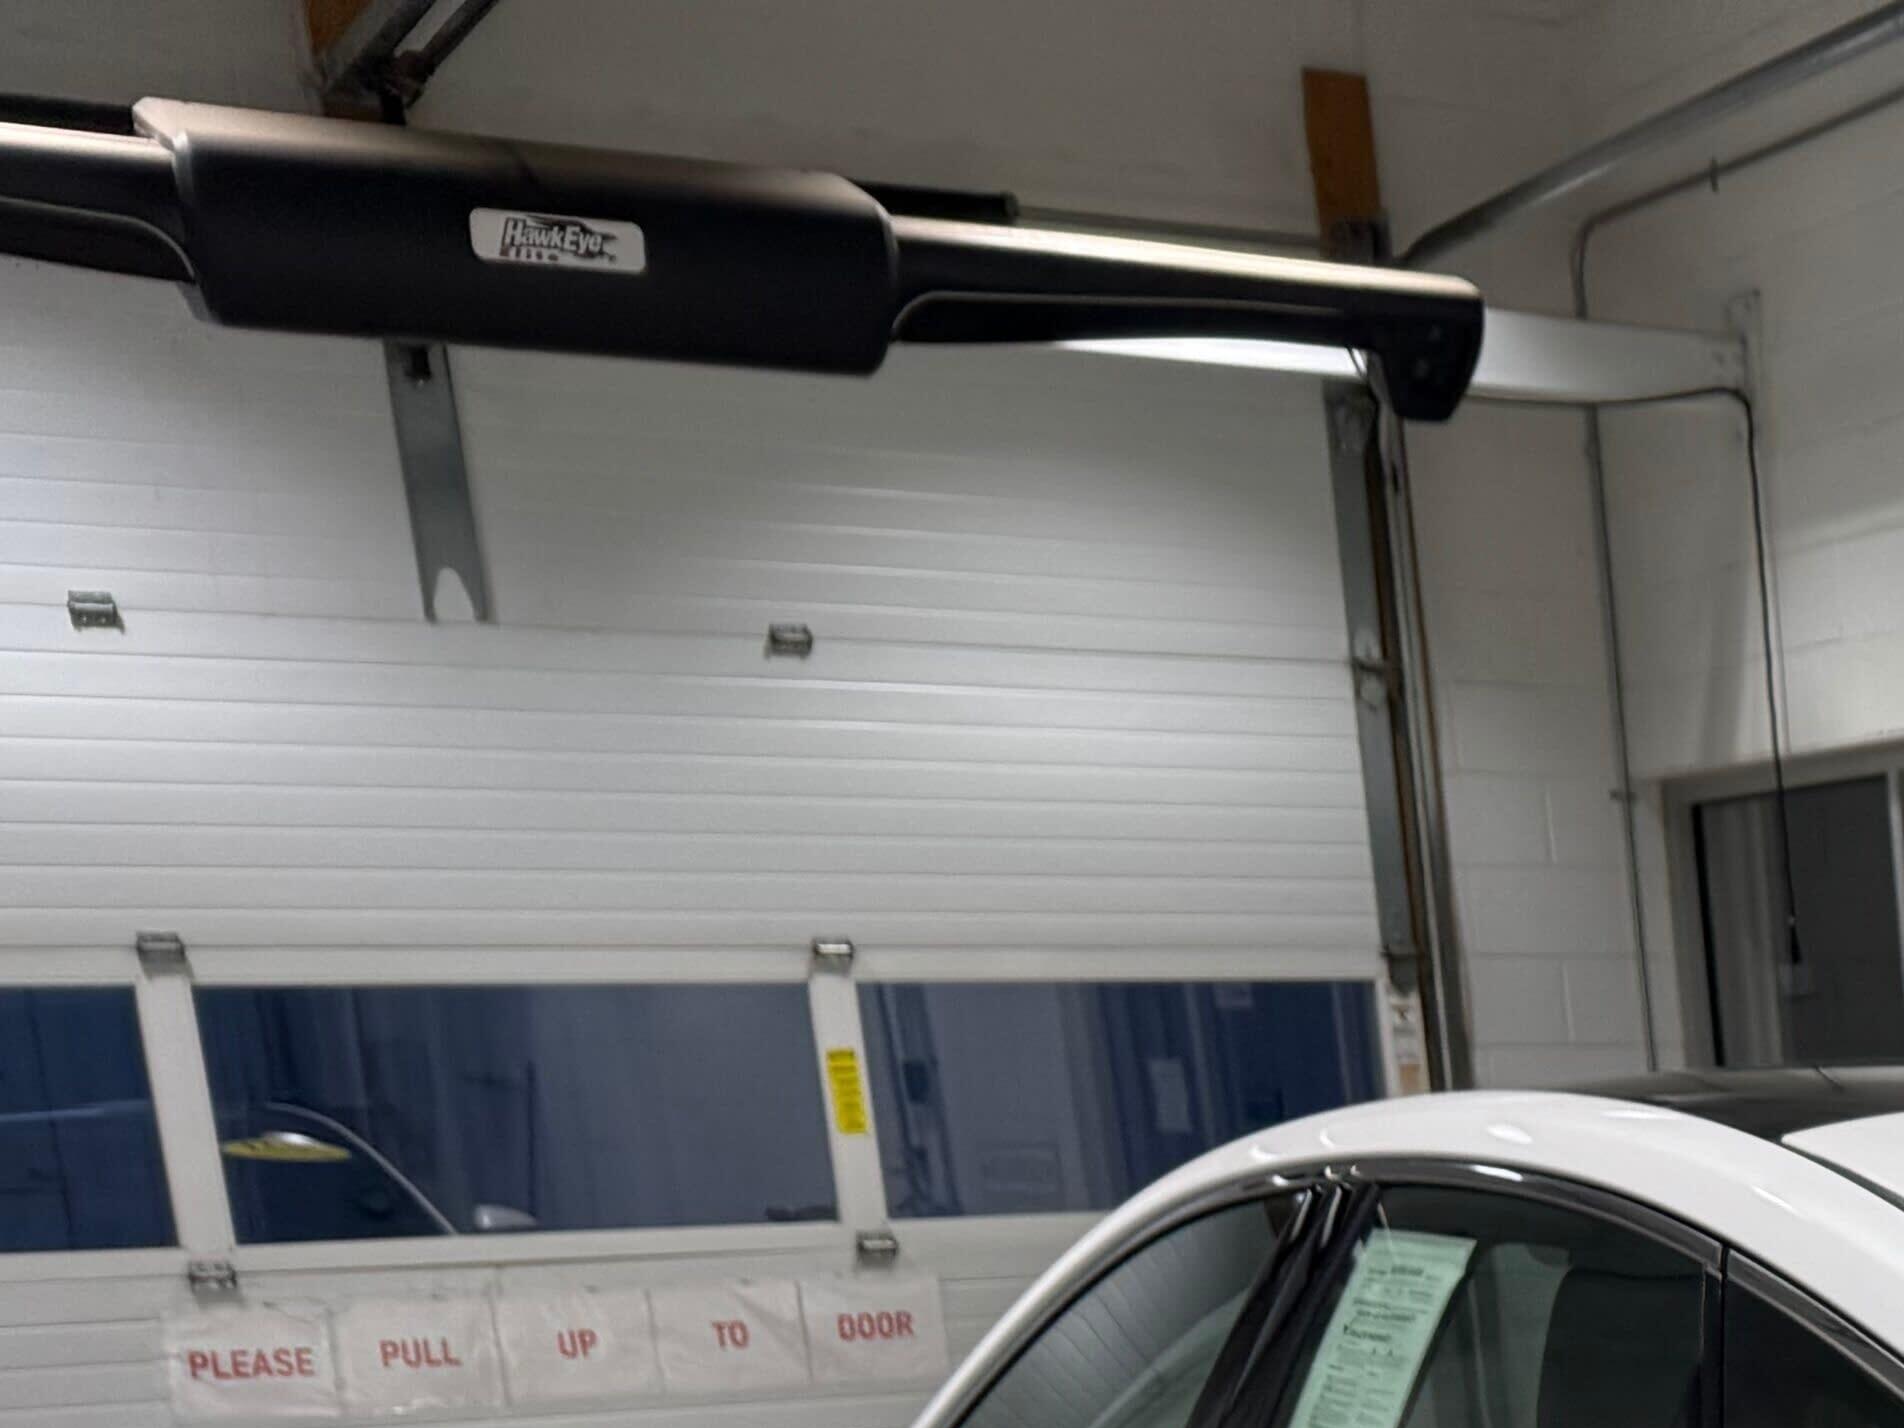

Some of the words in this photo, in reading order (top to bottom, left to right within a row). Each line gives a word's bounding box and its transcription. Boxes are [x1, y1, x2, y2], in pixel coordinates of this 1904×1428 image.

[502, 217, 602, 254] HawkEye
[188, 1347, 315, 1380] PLEASE
[379, 1336, 462, 1368] PULL
[557, 1328, 598, 1360] UP
[712, 1320, 750, 1350] TO
[837, 1309, 914, 1342] DOOR
